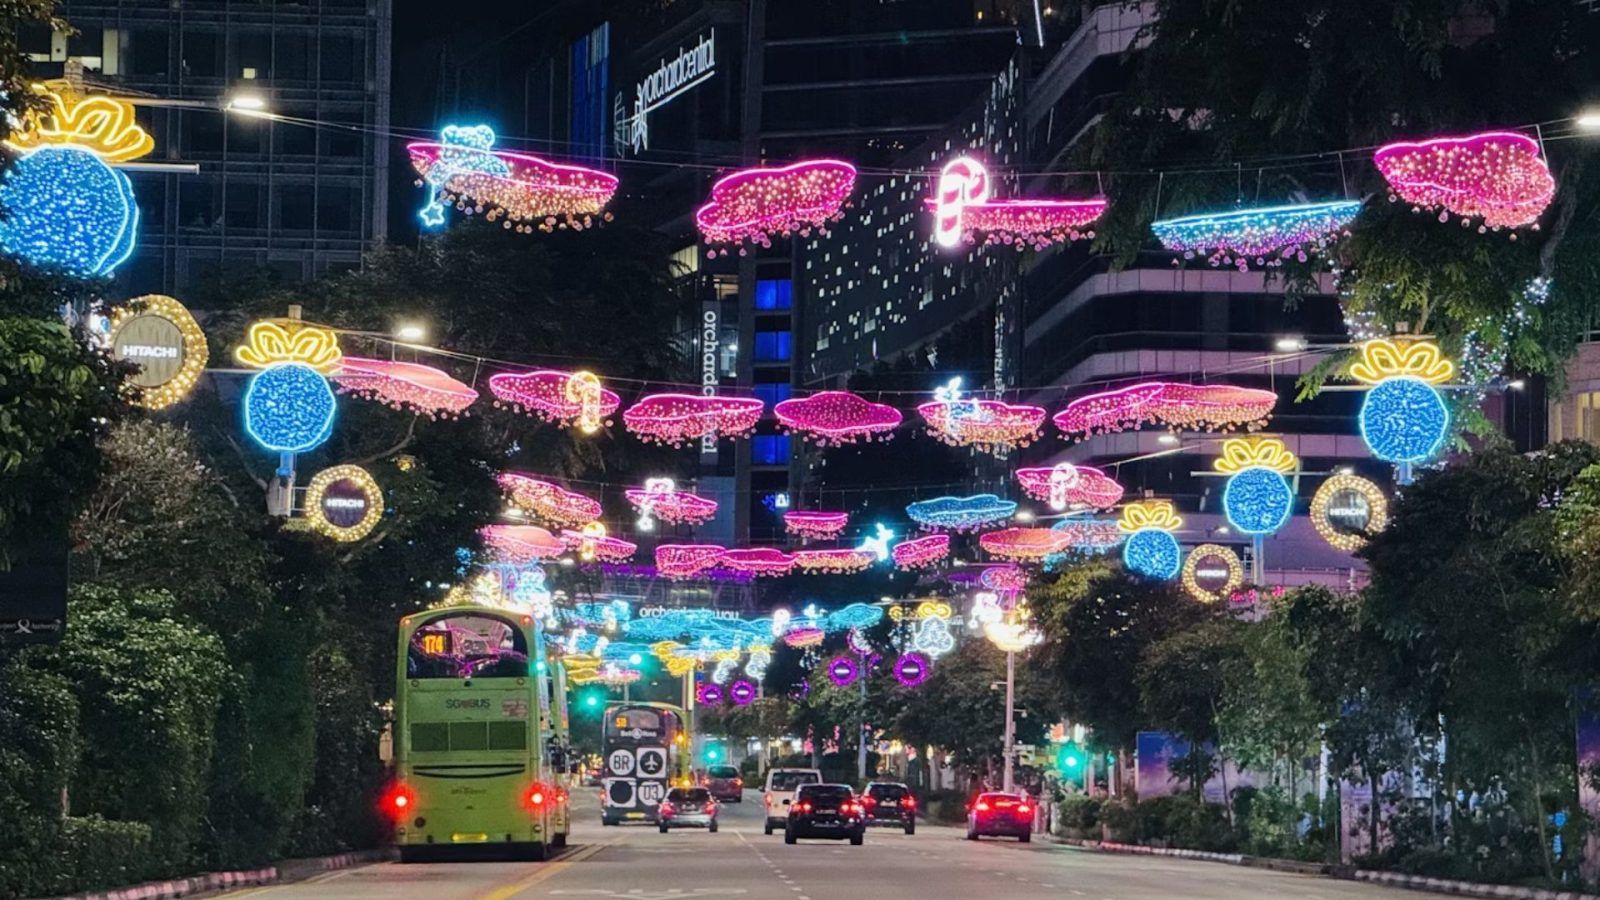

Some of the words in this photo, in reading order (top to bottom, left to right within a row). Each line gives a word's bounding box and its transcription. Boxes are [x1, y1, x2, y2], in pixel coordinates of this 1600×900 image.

[122, 345, 178, 358] HITACHI
[326, 498, 365, 508] HITACHI
[424, 635, 443, 653] 174
[613, 755, 630, 770] BR
